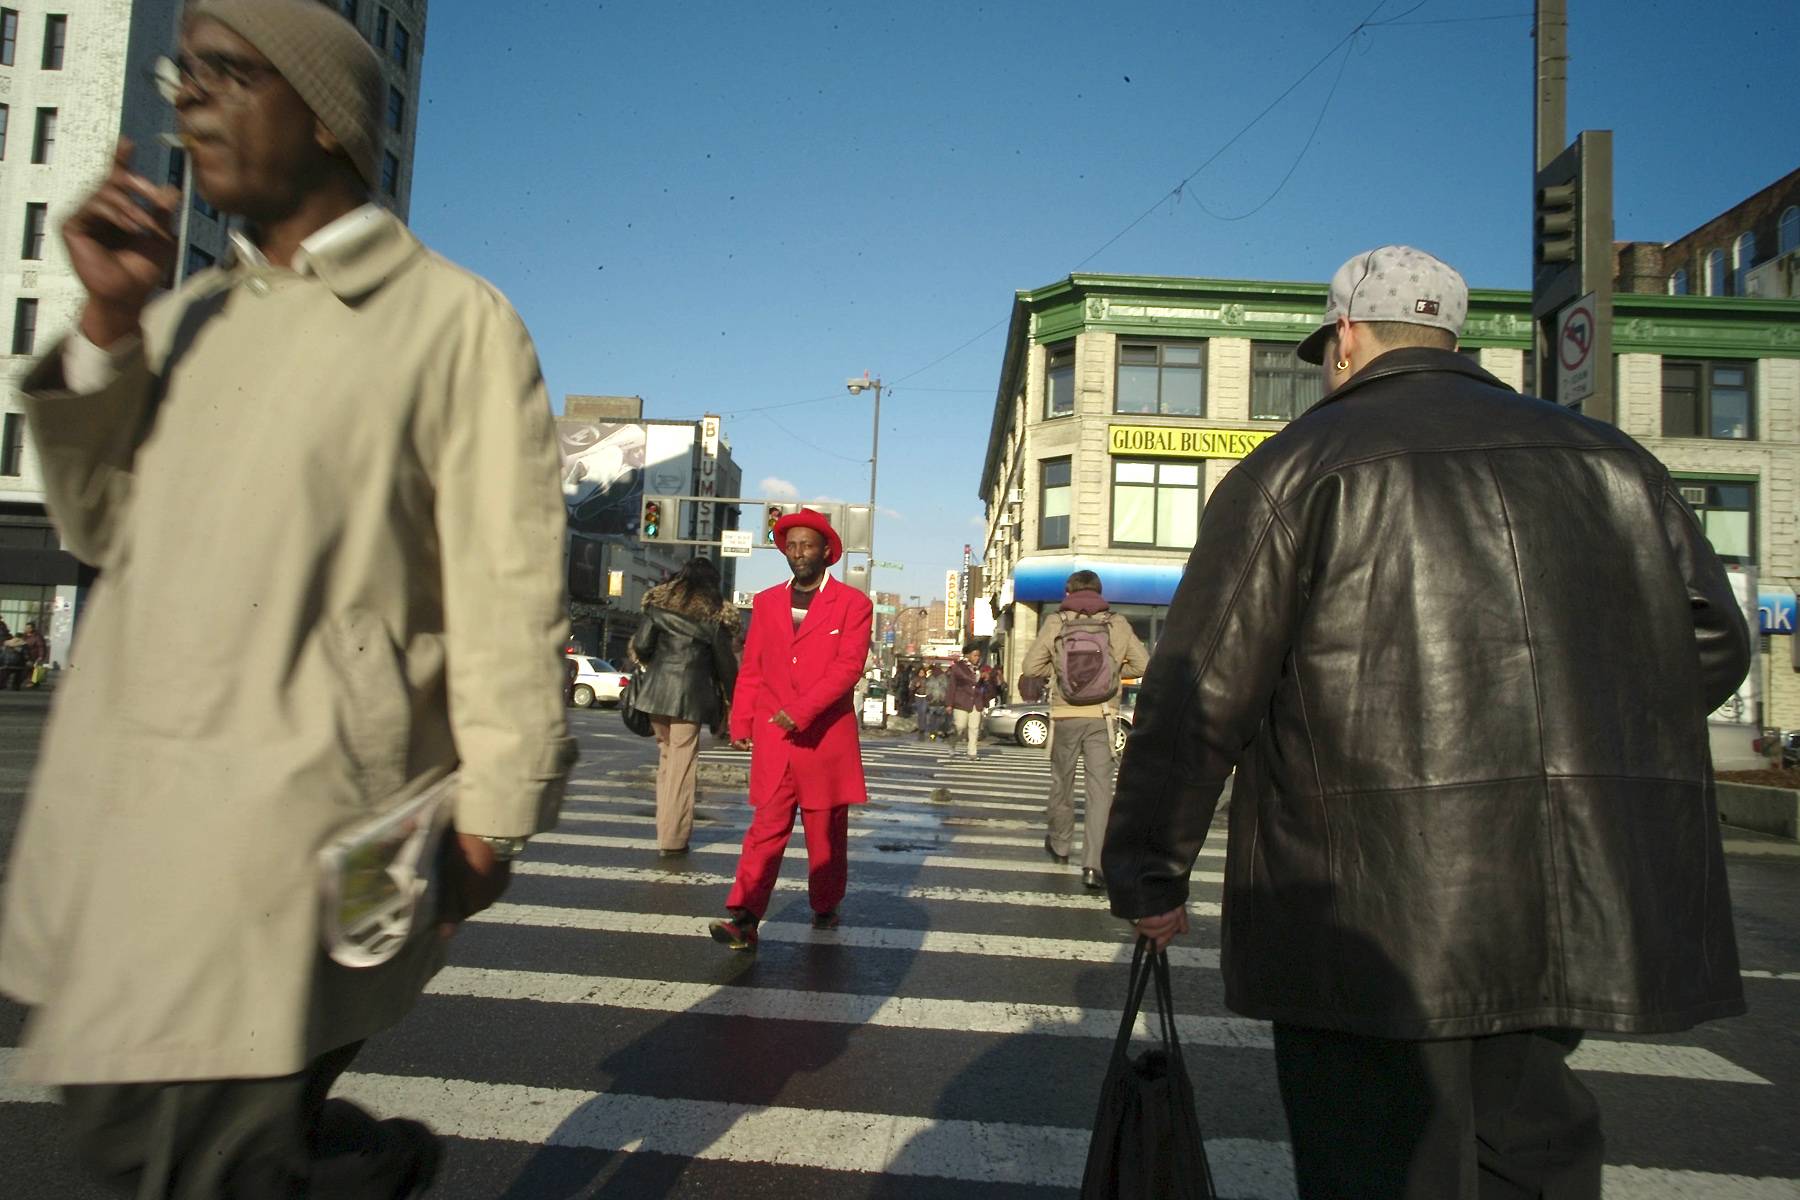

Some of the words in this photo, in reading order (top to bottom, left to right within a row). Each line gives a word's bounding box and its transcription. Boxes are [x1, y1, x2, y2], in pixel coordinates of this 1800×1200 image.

[1113, 429, 1176, 451] GLOBAL
[1181, 432, 1256, 454] BUSINESS
[947, 573, 956, 627] APOLLO
